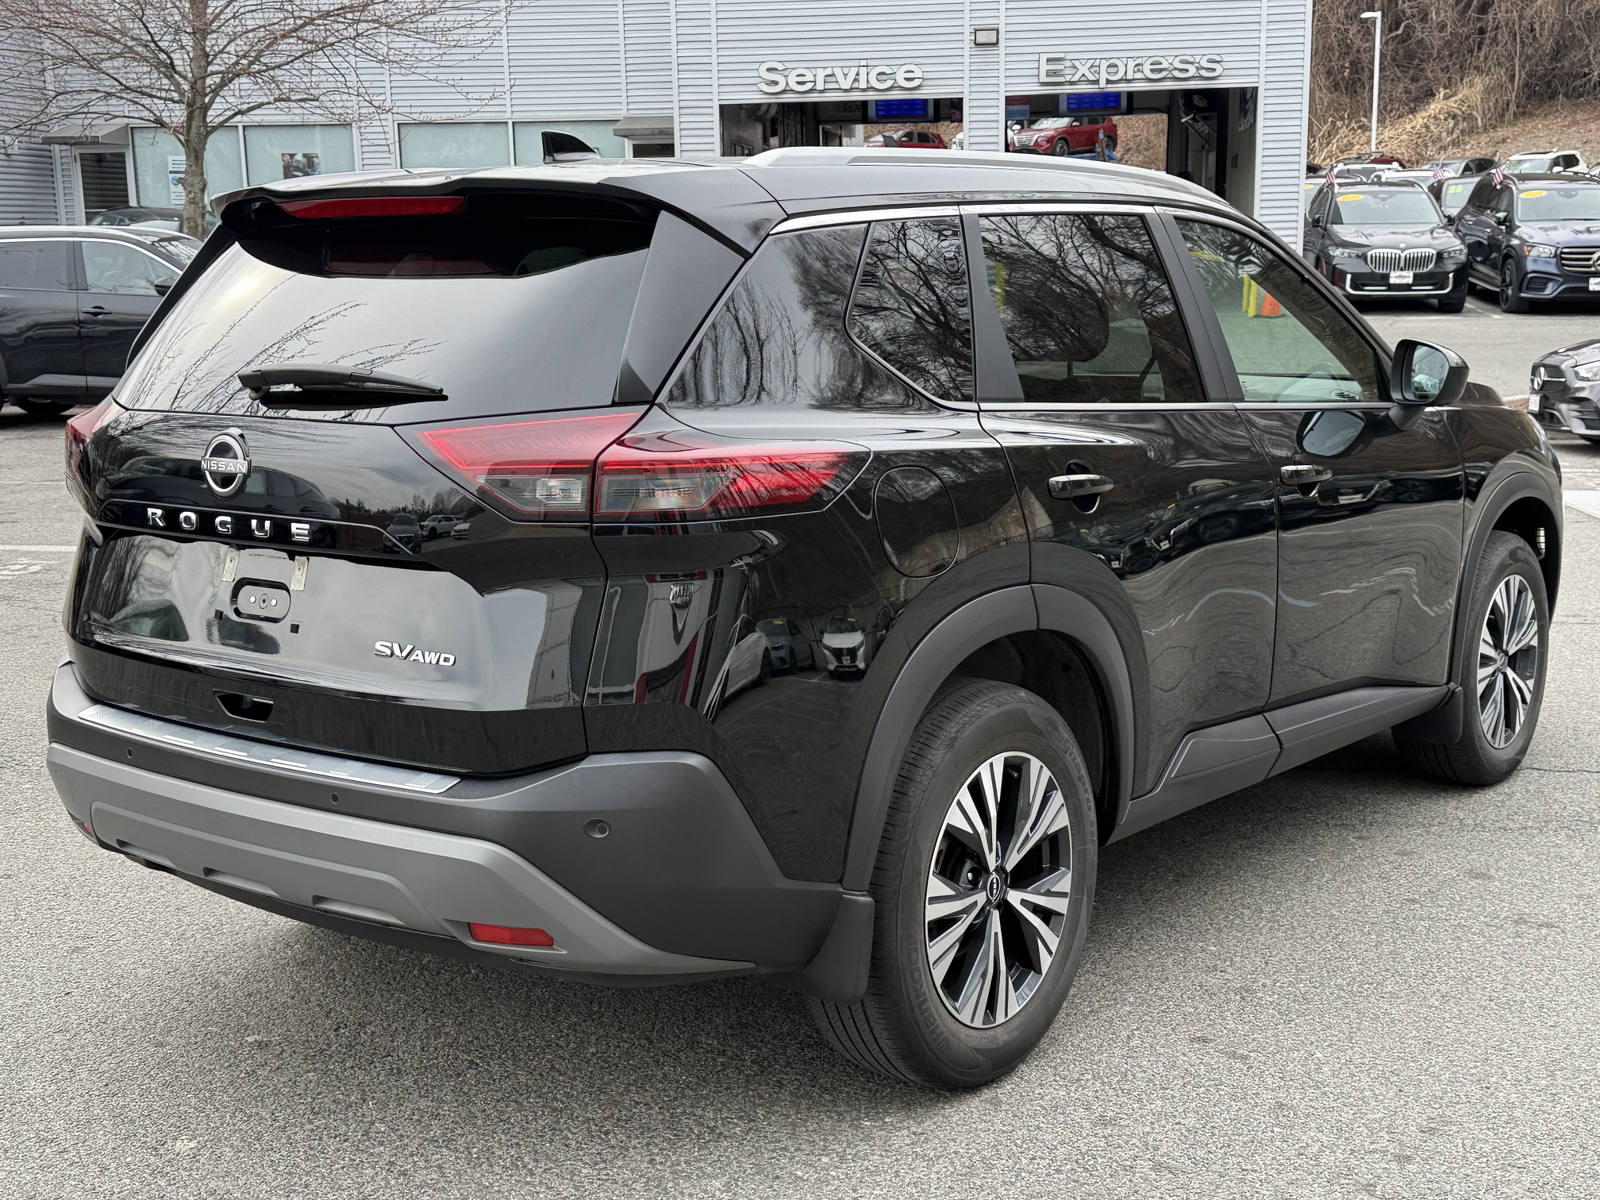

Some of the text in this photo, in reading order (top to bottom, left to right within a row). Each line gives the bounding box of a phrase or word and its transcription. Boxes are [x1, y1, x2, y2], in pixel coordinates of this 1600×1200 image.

[757, 52, 1225, 94] Service Express
[201, 459, 246, 472] NISSAN
[146, 507, 312, 542] ROGUE
[374, 640, 457, 667] SV AWD
